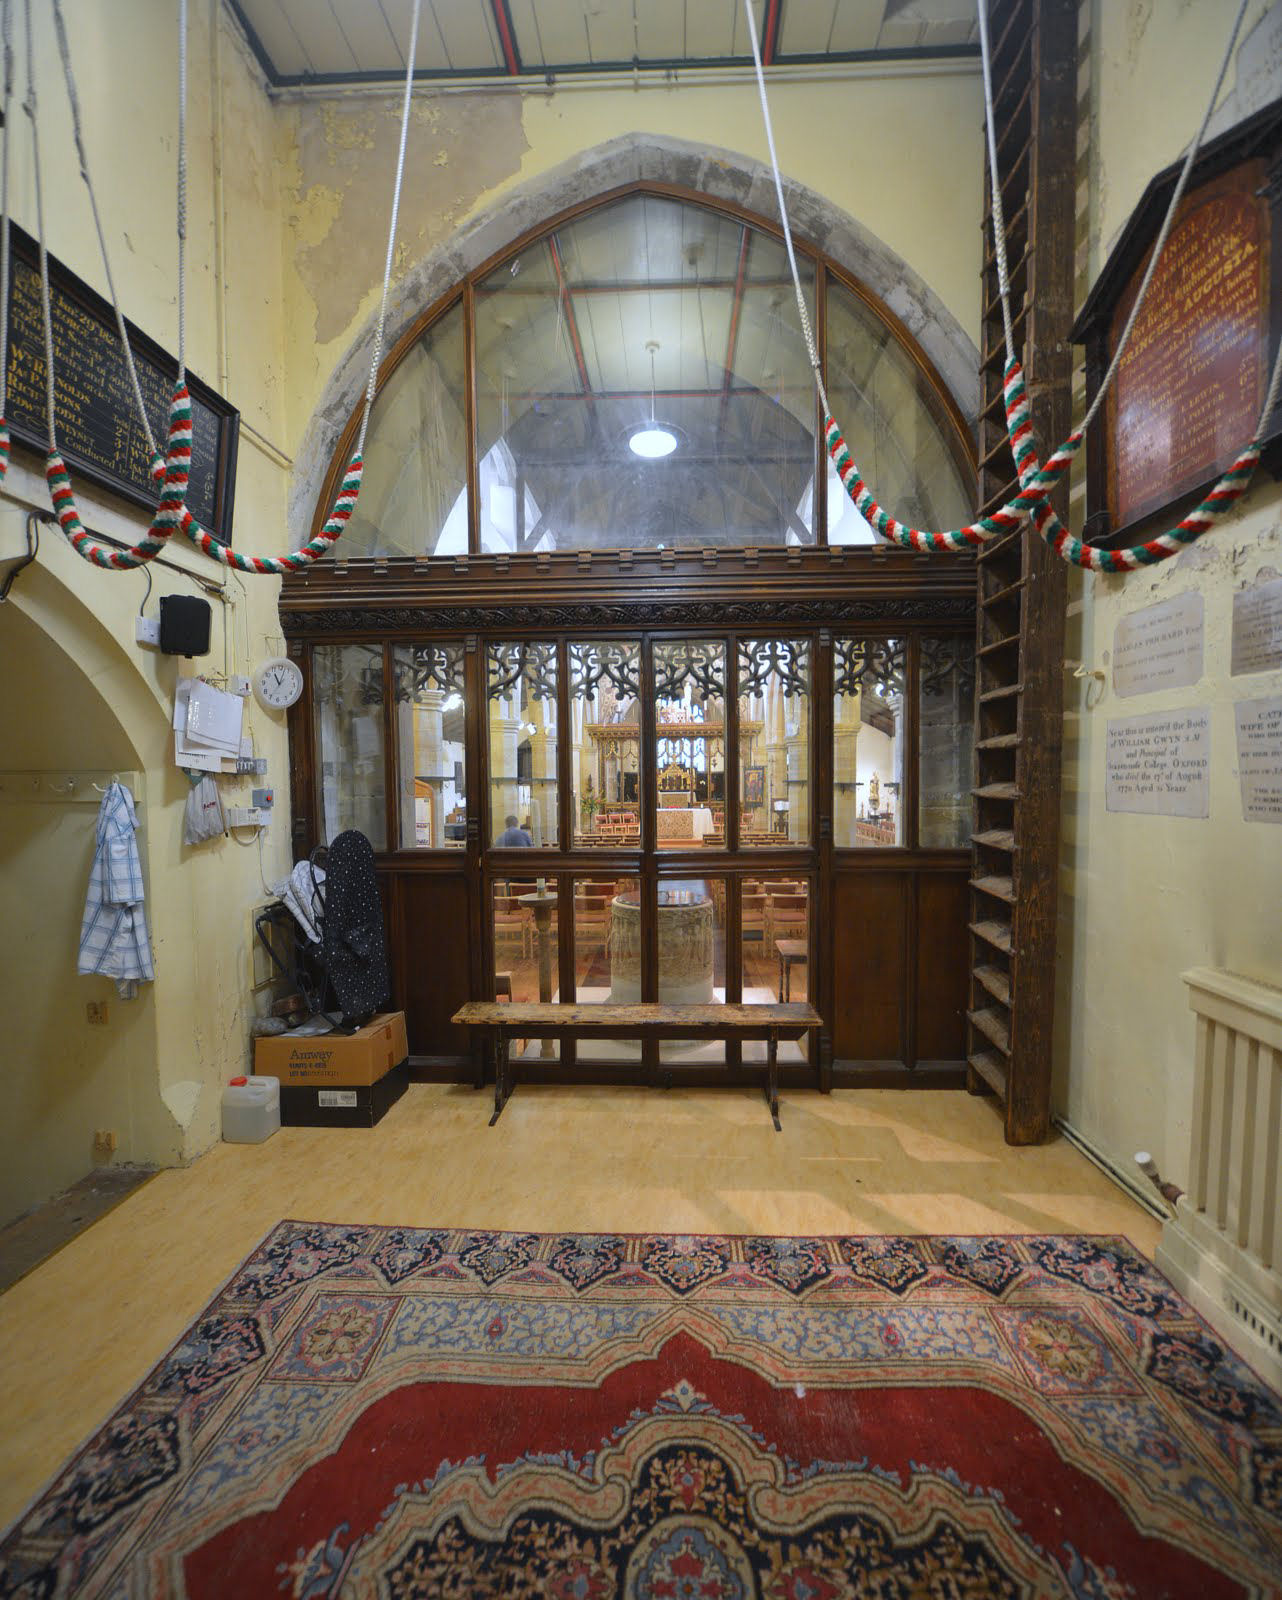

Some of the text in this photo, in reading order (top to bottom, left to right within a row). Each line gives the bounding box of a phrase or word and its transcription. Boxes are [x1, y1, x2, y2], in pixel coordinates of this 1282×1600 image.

[1118, 306, 1180, 370] PRINCESS
[63, 434, 115, 470] Conducted
[1172, 720, 1185, 730] the
[1186, 717, 1208, 729] Body
[1153, 735, 1181, 745] GWYN
[1125, 748, 1138, 759] and
[1170, 746, 1178, 756] of
[1172, 758, 1208, 768] OXFORD
[1141, 771, 1151, 780] the
[288, 1048, 334, 1063] Amway
